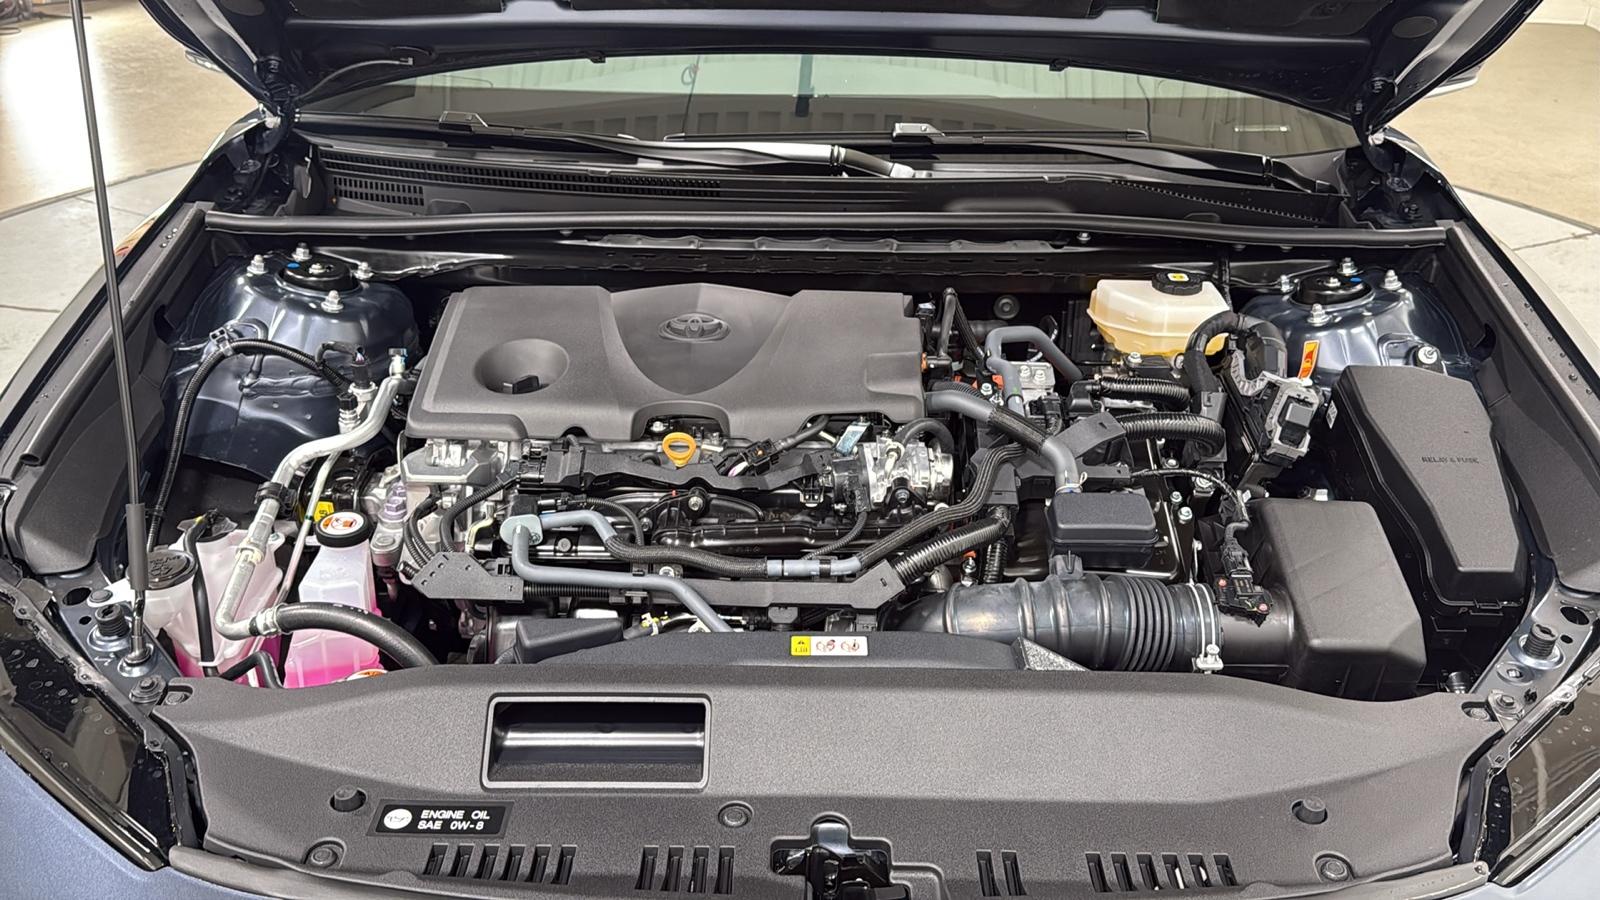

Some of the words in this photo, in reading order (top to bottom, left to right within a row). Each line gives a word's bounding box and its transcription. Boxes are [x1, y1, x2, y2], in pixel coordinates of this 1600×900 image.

[420, 809, 465, 819] ENGINE
[471, 810, 490, 820] OIL
[417, 820, 443, 829] SAE
